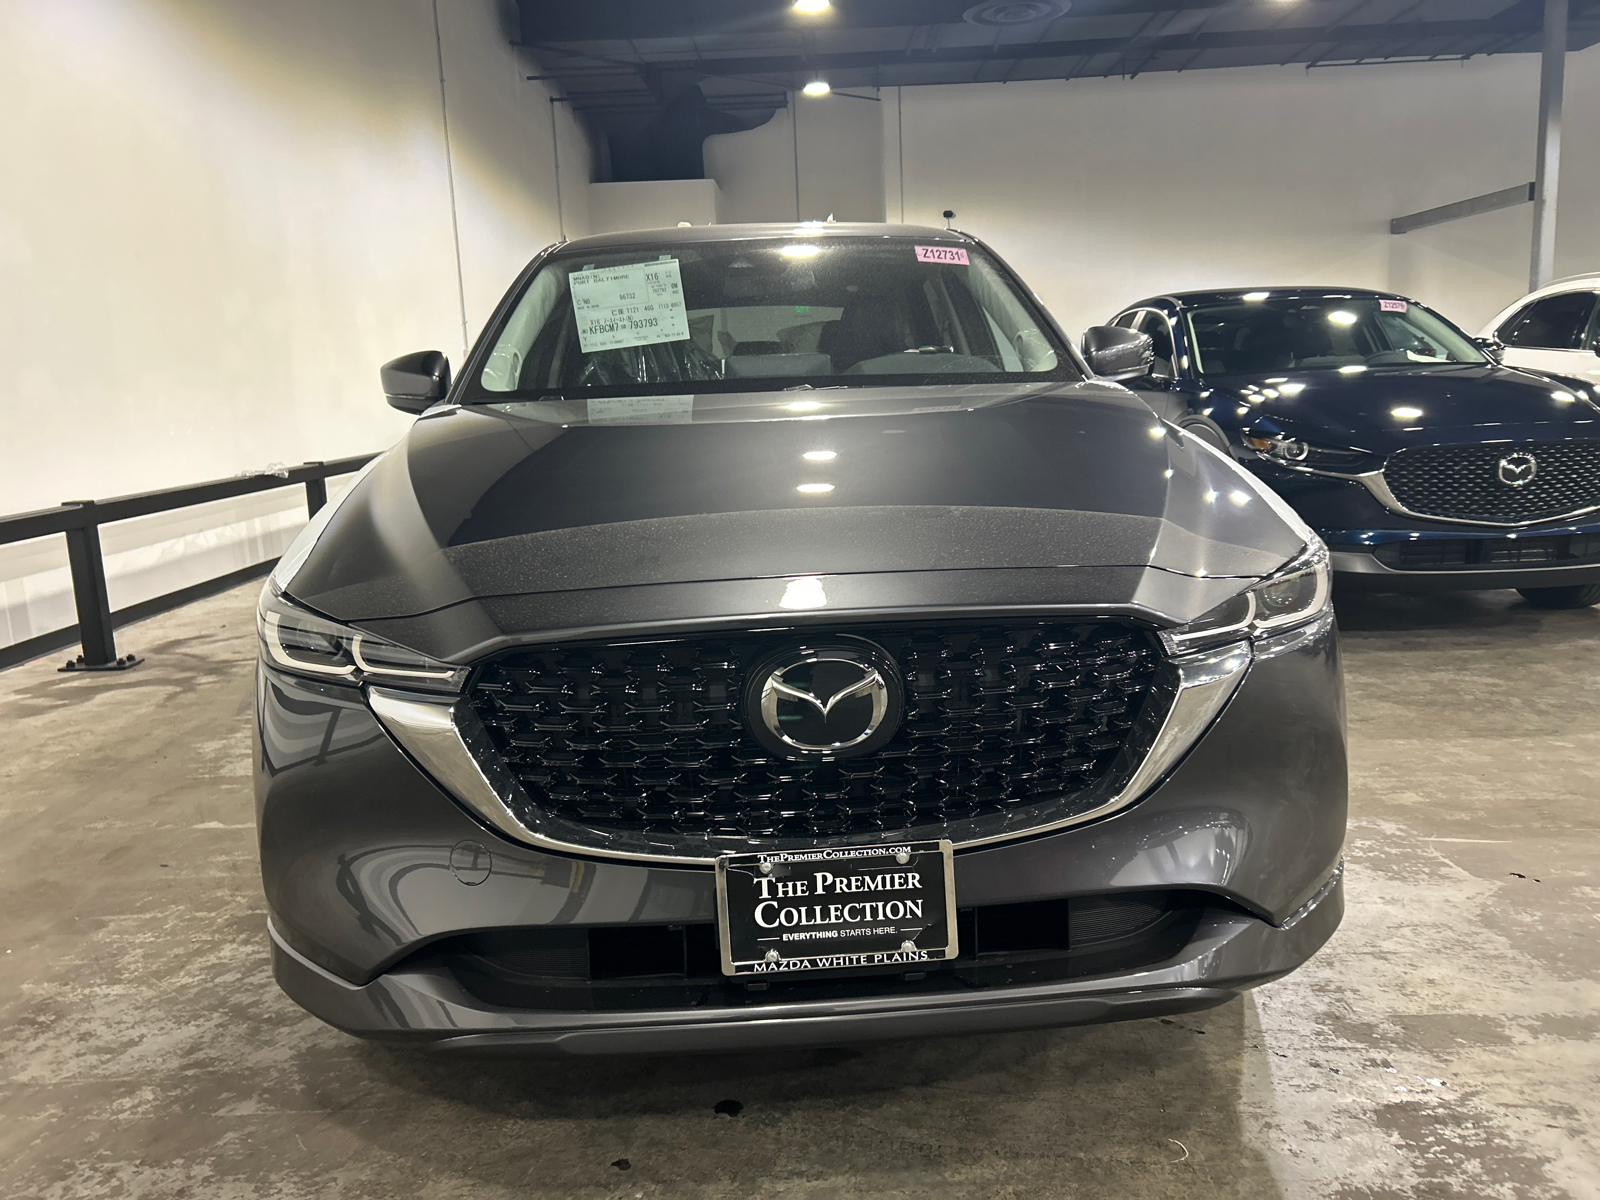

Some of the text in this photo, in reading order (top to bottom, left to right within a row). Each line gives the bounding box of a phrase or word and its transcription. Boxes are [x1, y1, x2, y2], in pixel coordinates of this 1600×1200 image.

[921, 248, 961, 261] Z12731
[593, 274, 630, 283] BALTIMORE
[645, 272, 659, 281] X16
[619, 292, 636, 300] 96732
[588, 322, 619, 335] KFBCM7
[629, 317, 658, 329] 793793
[753, 872, 923, 899] THE PREMIER
[754, 899, 923, 928] COLLECTION
[782, 926, 898, 941] EVERYTHING STARTS HERE.
[754, 950, 928, 973] MAZDA WHITE PLAINS
